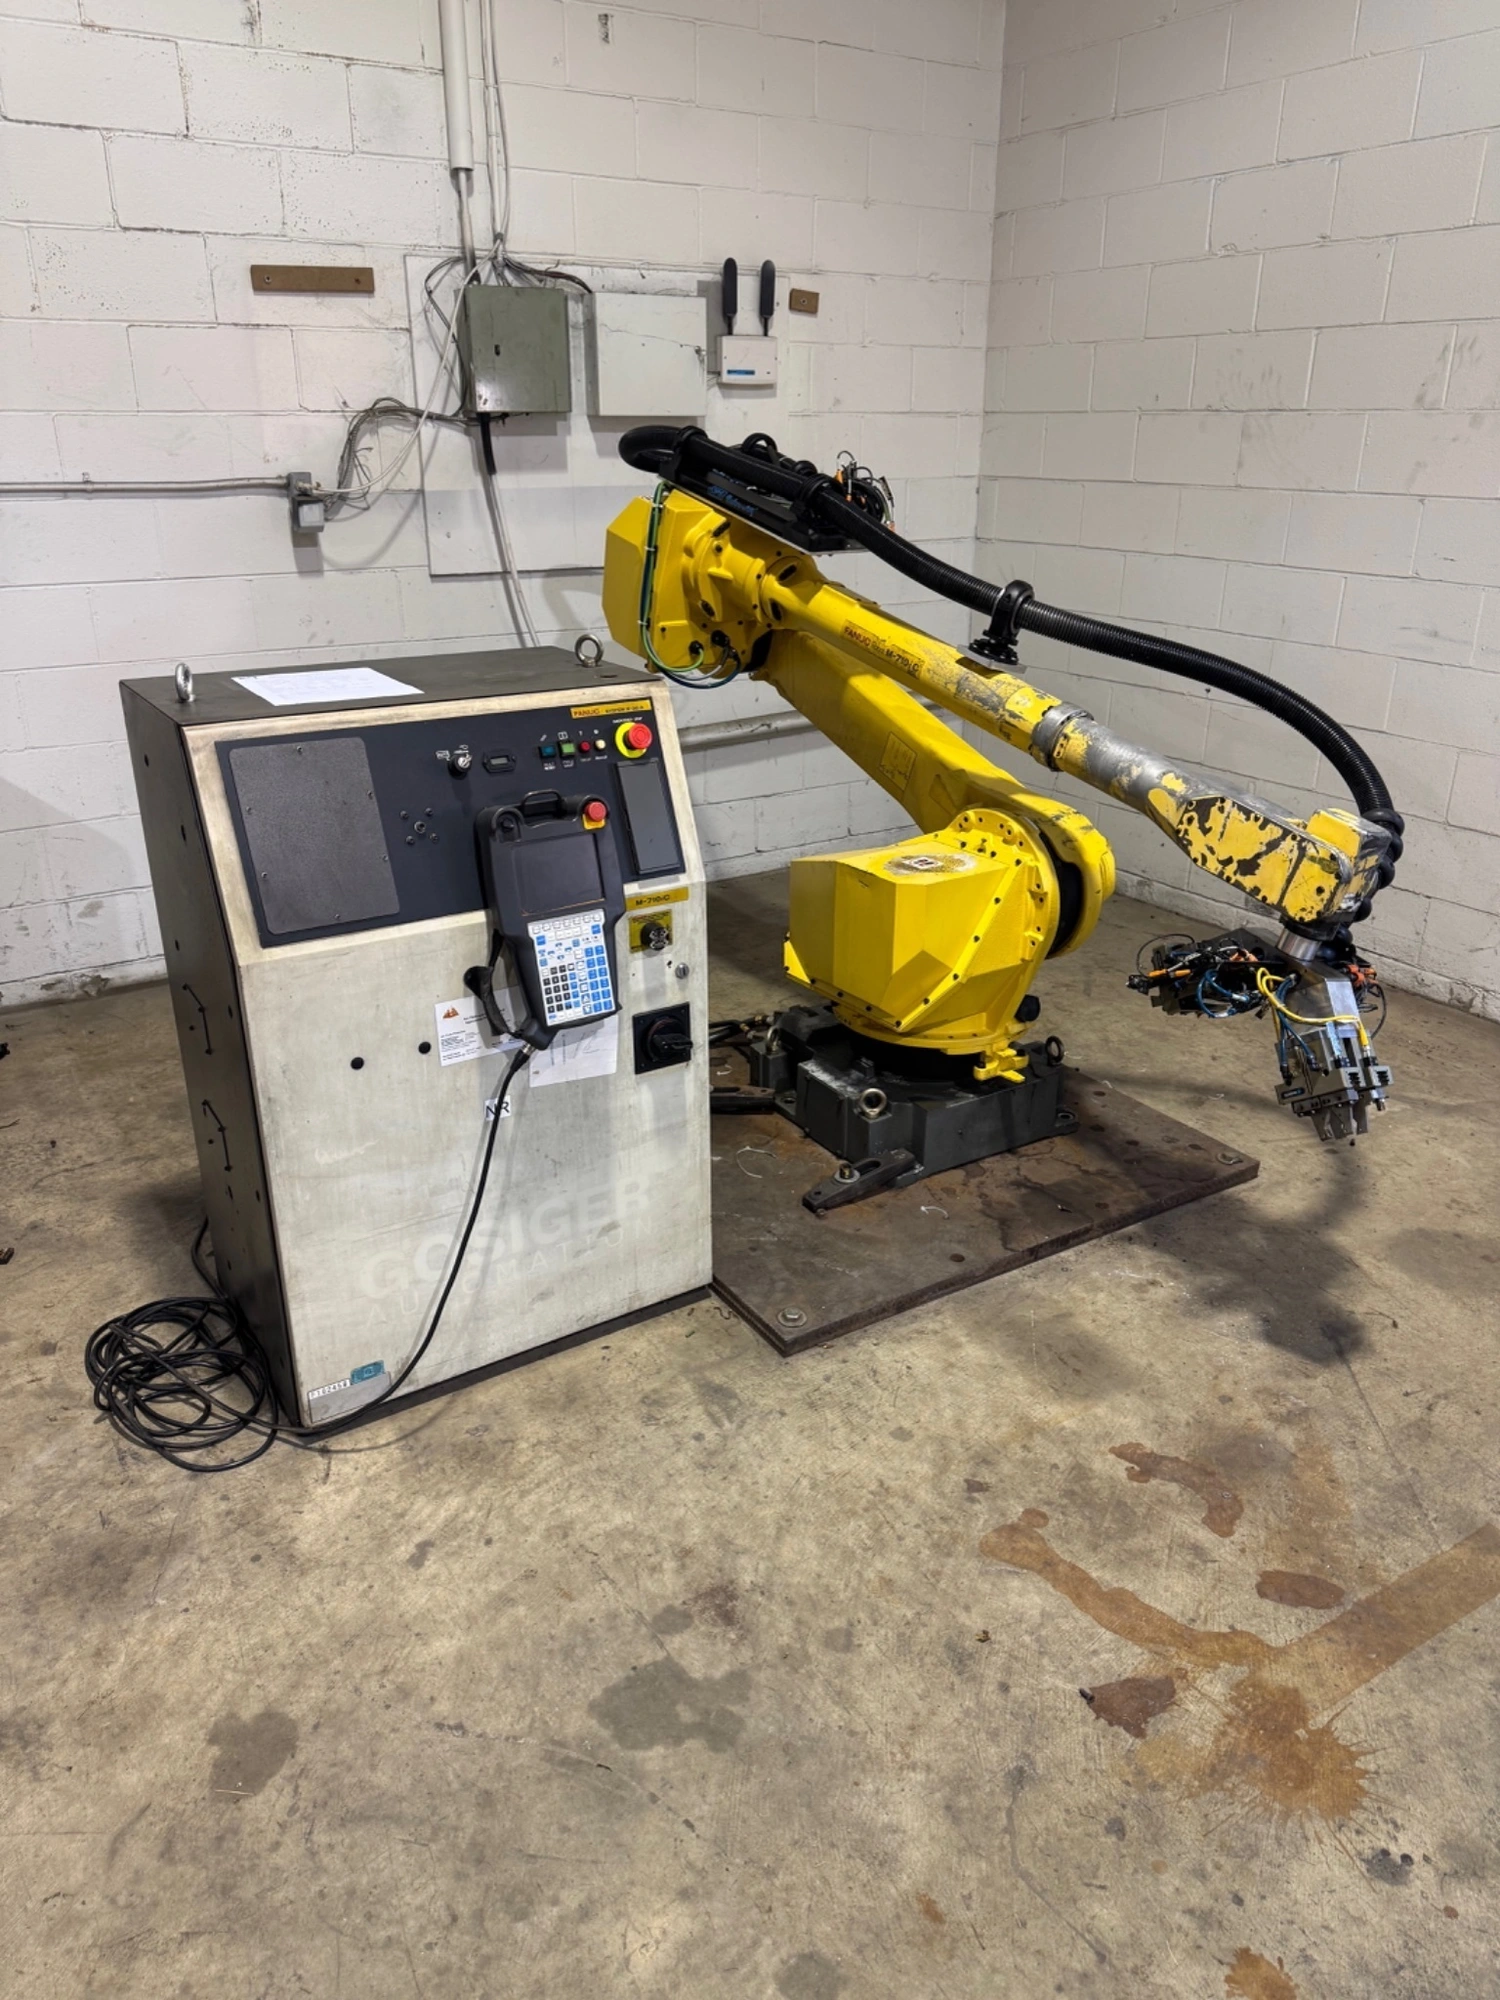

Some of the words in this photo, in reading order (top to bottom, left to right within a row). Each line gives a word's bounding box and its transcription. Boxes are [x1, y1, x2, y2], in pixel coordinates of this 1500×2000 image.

[844, 626, 870, 646] FANUC
[573, 708, 600, 717] FANUC
[358, 1176, 652, 1299] GOSIGER
[363, 1218, 655, 1329] AUOMATION
